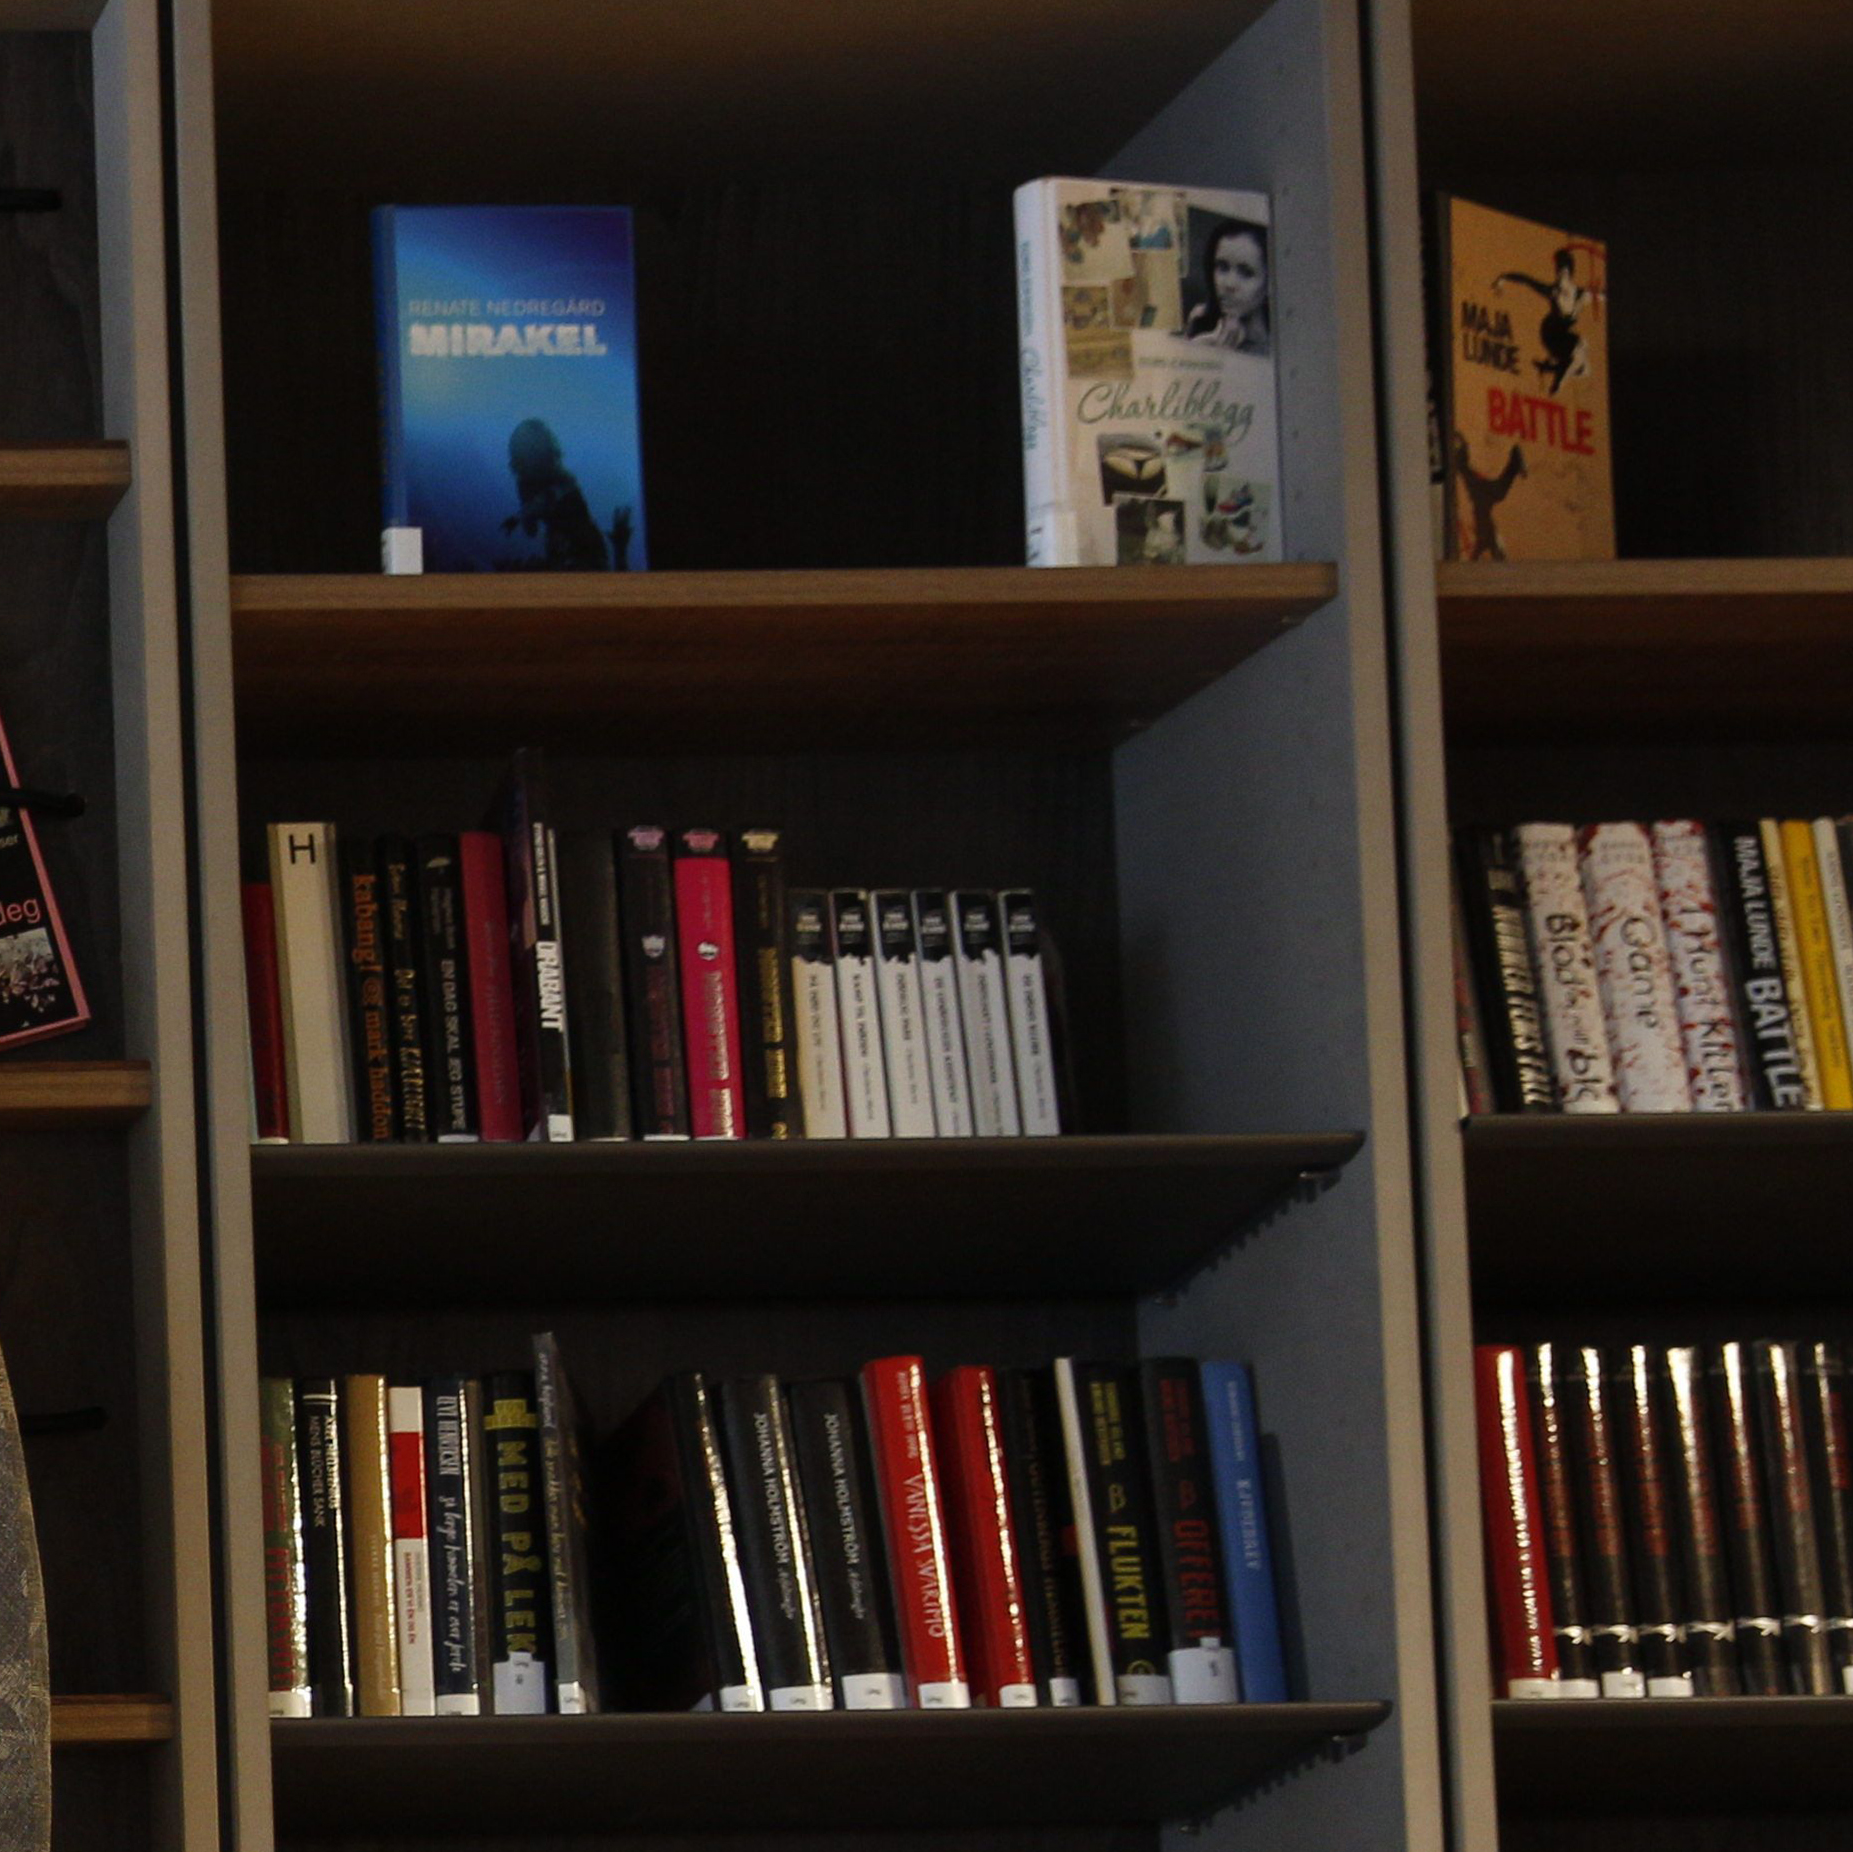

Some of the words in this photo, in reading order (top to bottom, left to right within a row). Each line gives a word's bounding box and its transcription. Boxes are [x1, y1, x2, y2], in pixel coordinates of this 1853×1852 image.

[408, 323, 608, 357] MIRAKEL
[1488, 387, 1595, 455] BATTLE
[1733, 836, 1762, 898] MAJA
[352, 874, 382, 973] kabang!
[1743, 900, 1777, 969] LUNDE
[535, 940, 563, 1033] DRABANT
[365, 1011, 387, 1063] mark
[1744, 977, 1804, 1107] BATTLE
[369, 1067, 391, 1139] haddon
[496, 1441, 531, 1514] MED
[753, 1412, 775, 1477] JOHANNA
[822, 1412, 846, 1477] JOHANNA
[501, 1531, 542, 1576] PÅ
[1105, 1524, 1150, 1640] FLUKTEN
